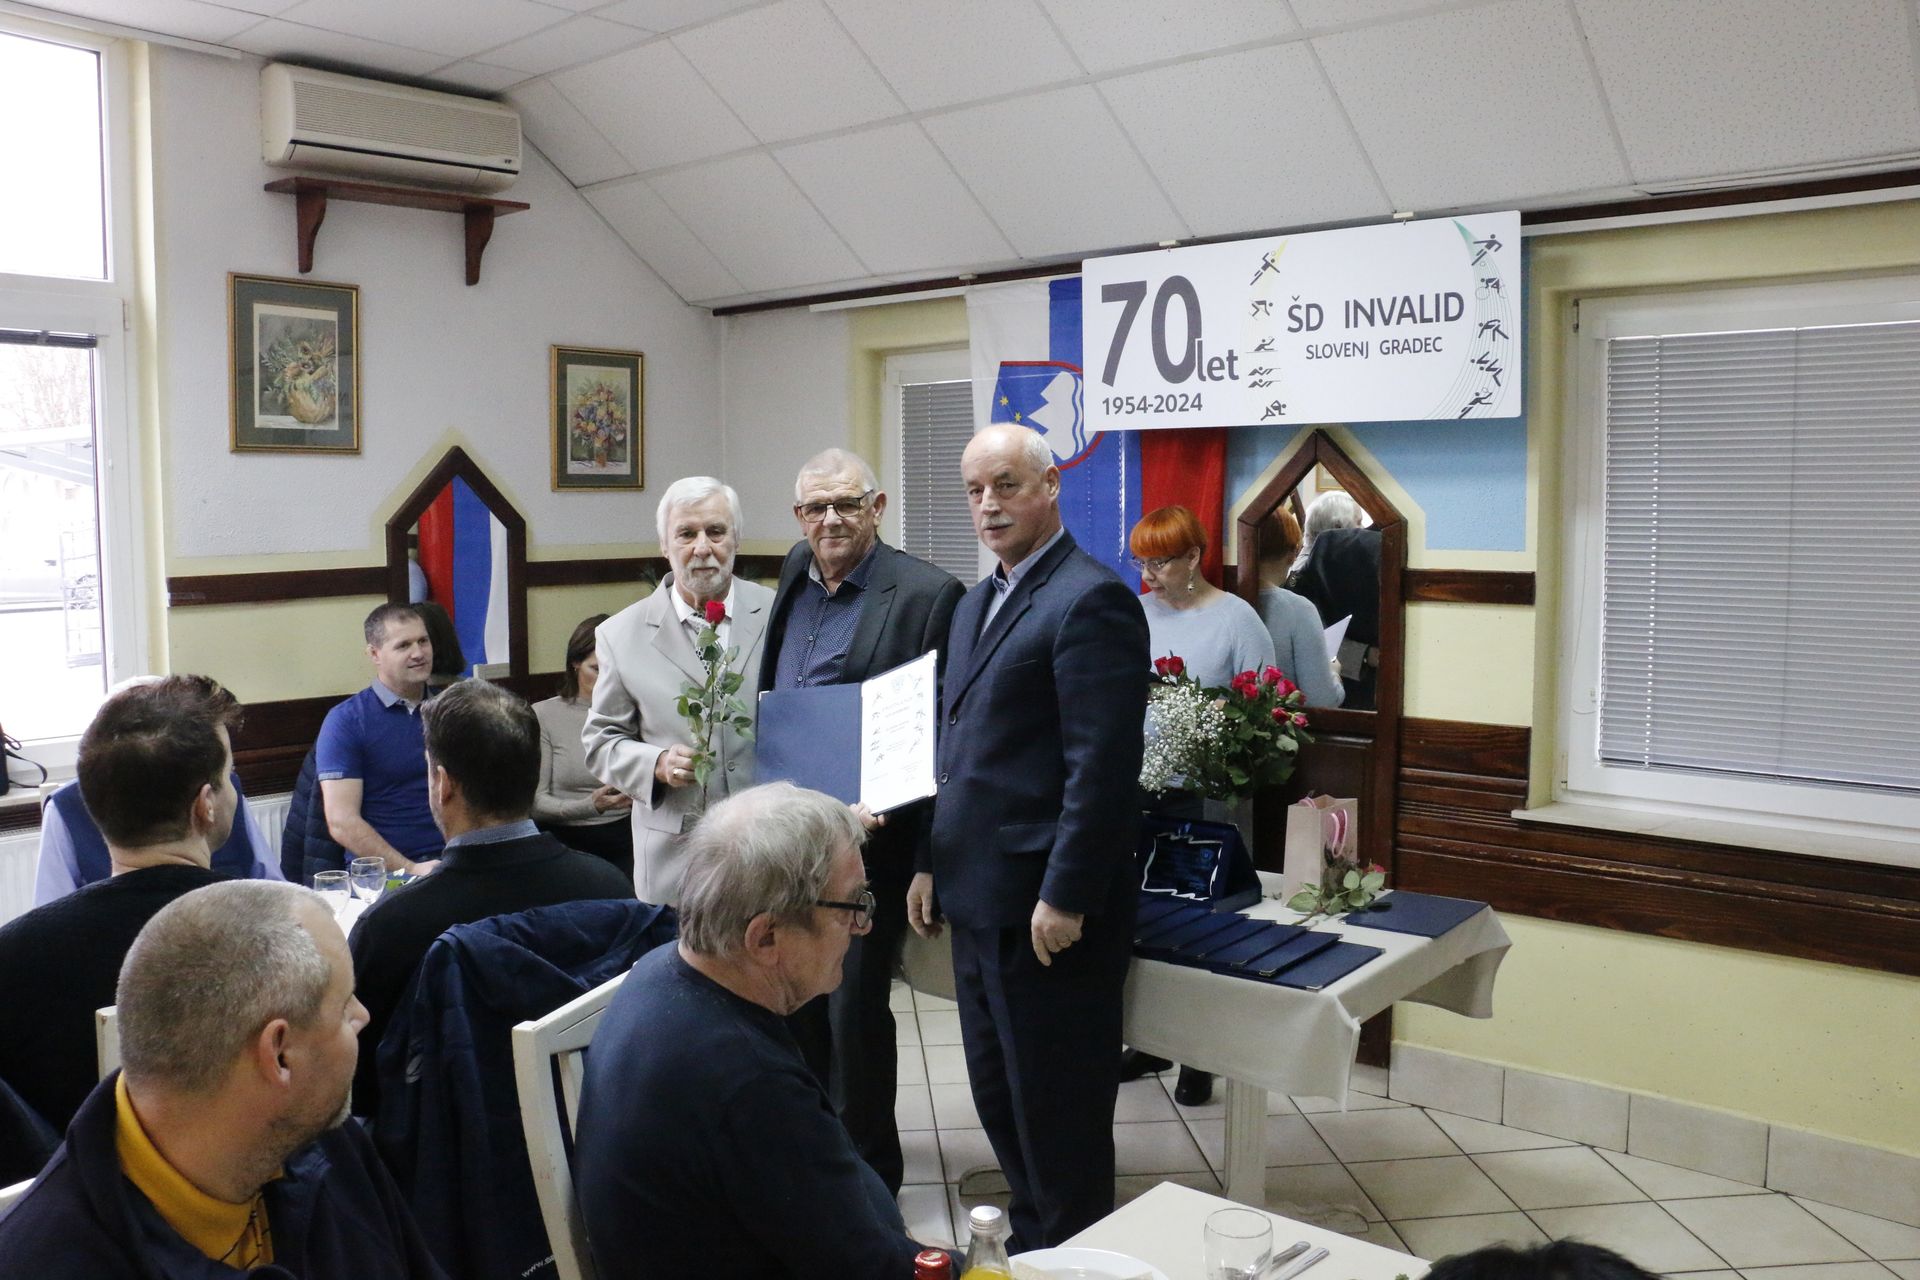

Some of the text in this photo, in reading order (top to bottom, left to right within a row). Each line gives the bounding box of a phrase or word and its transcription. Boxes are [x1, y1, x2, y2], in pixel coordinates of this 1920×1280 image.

[1287, 291, 1465, 333] ŠD INVALID
[1101, 275, 1239, 387] 70 let
[1305, 336, 1443, 360] SLOVENJ GRADEC
[1102, 393, 1203, 416] 1954-2024
